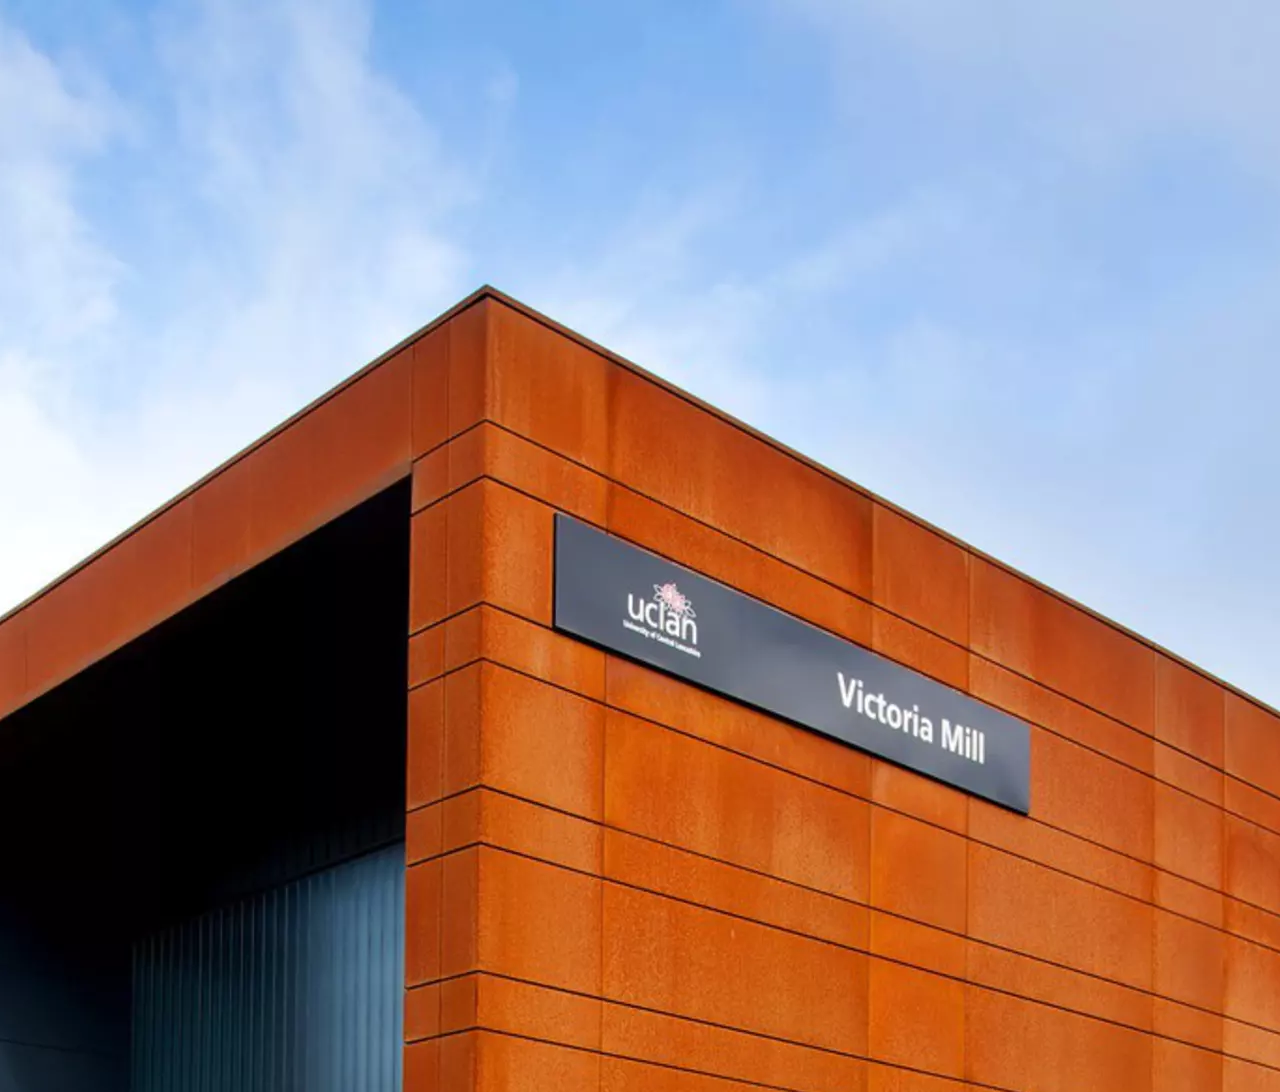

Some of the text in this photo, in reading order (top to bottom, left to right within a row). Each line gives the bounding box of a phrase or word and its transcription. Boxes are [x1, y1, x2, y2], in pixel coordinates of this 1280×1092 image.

[628, 593, 697, 645] uclan
[837, 672, 985, 764] Victoria Mill
